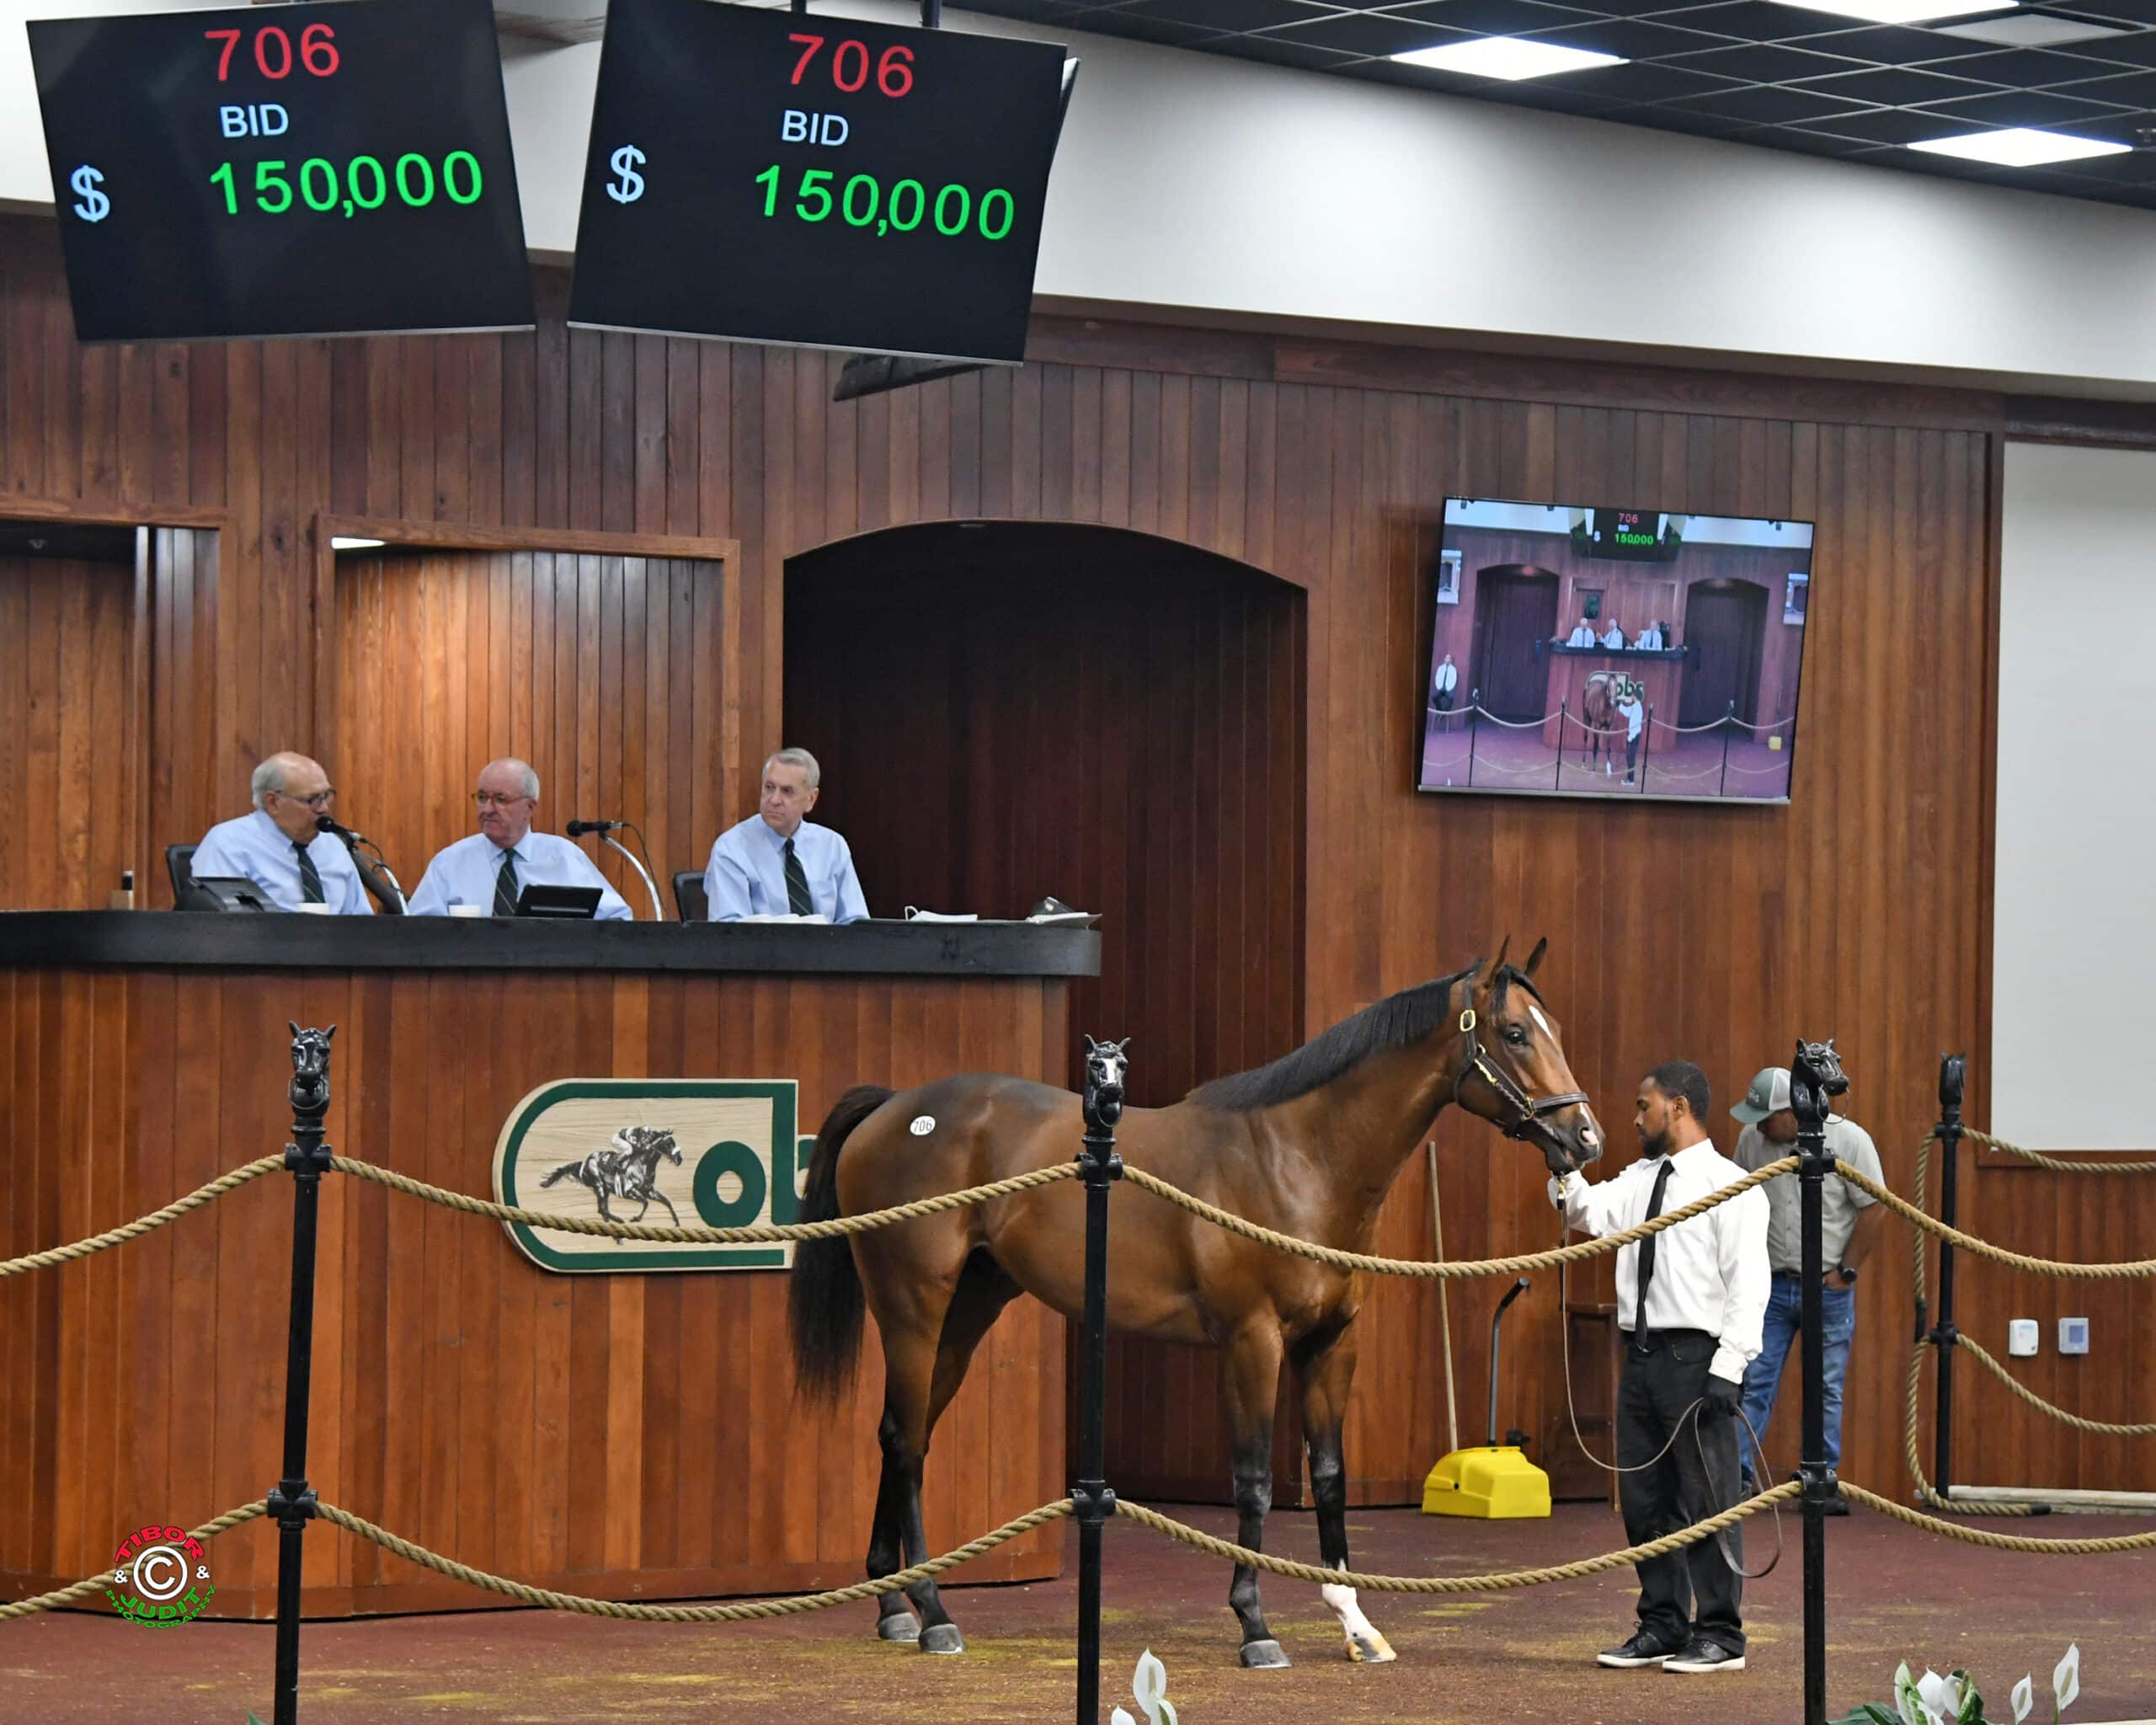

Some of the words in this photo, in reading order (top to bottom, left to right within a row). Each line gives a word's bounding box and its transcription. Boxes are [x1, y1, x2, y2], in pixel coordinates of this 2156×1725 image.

[205, 24, 340, 82] 706
[788, 33, 915, 98] 706
[220, 104, 289, 138] BID
[782, 109, 849, 147] BID
[71, 164, 110, 223] $
[210, 150, 483, 218] 150,000
[606, 144, 647, 204] $
[755, 164, 1014, 240] 150,000
[1618, 512, 1638, 523] 706
[913, 1119, 933, 1133] 706
